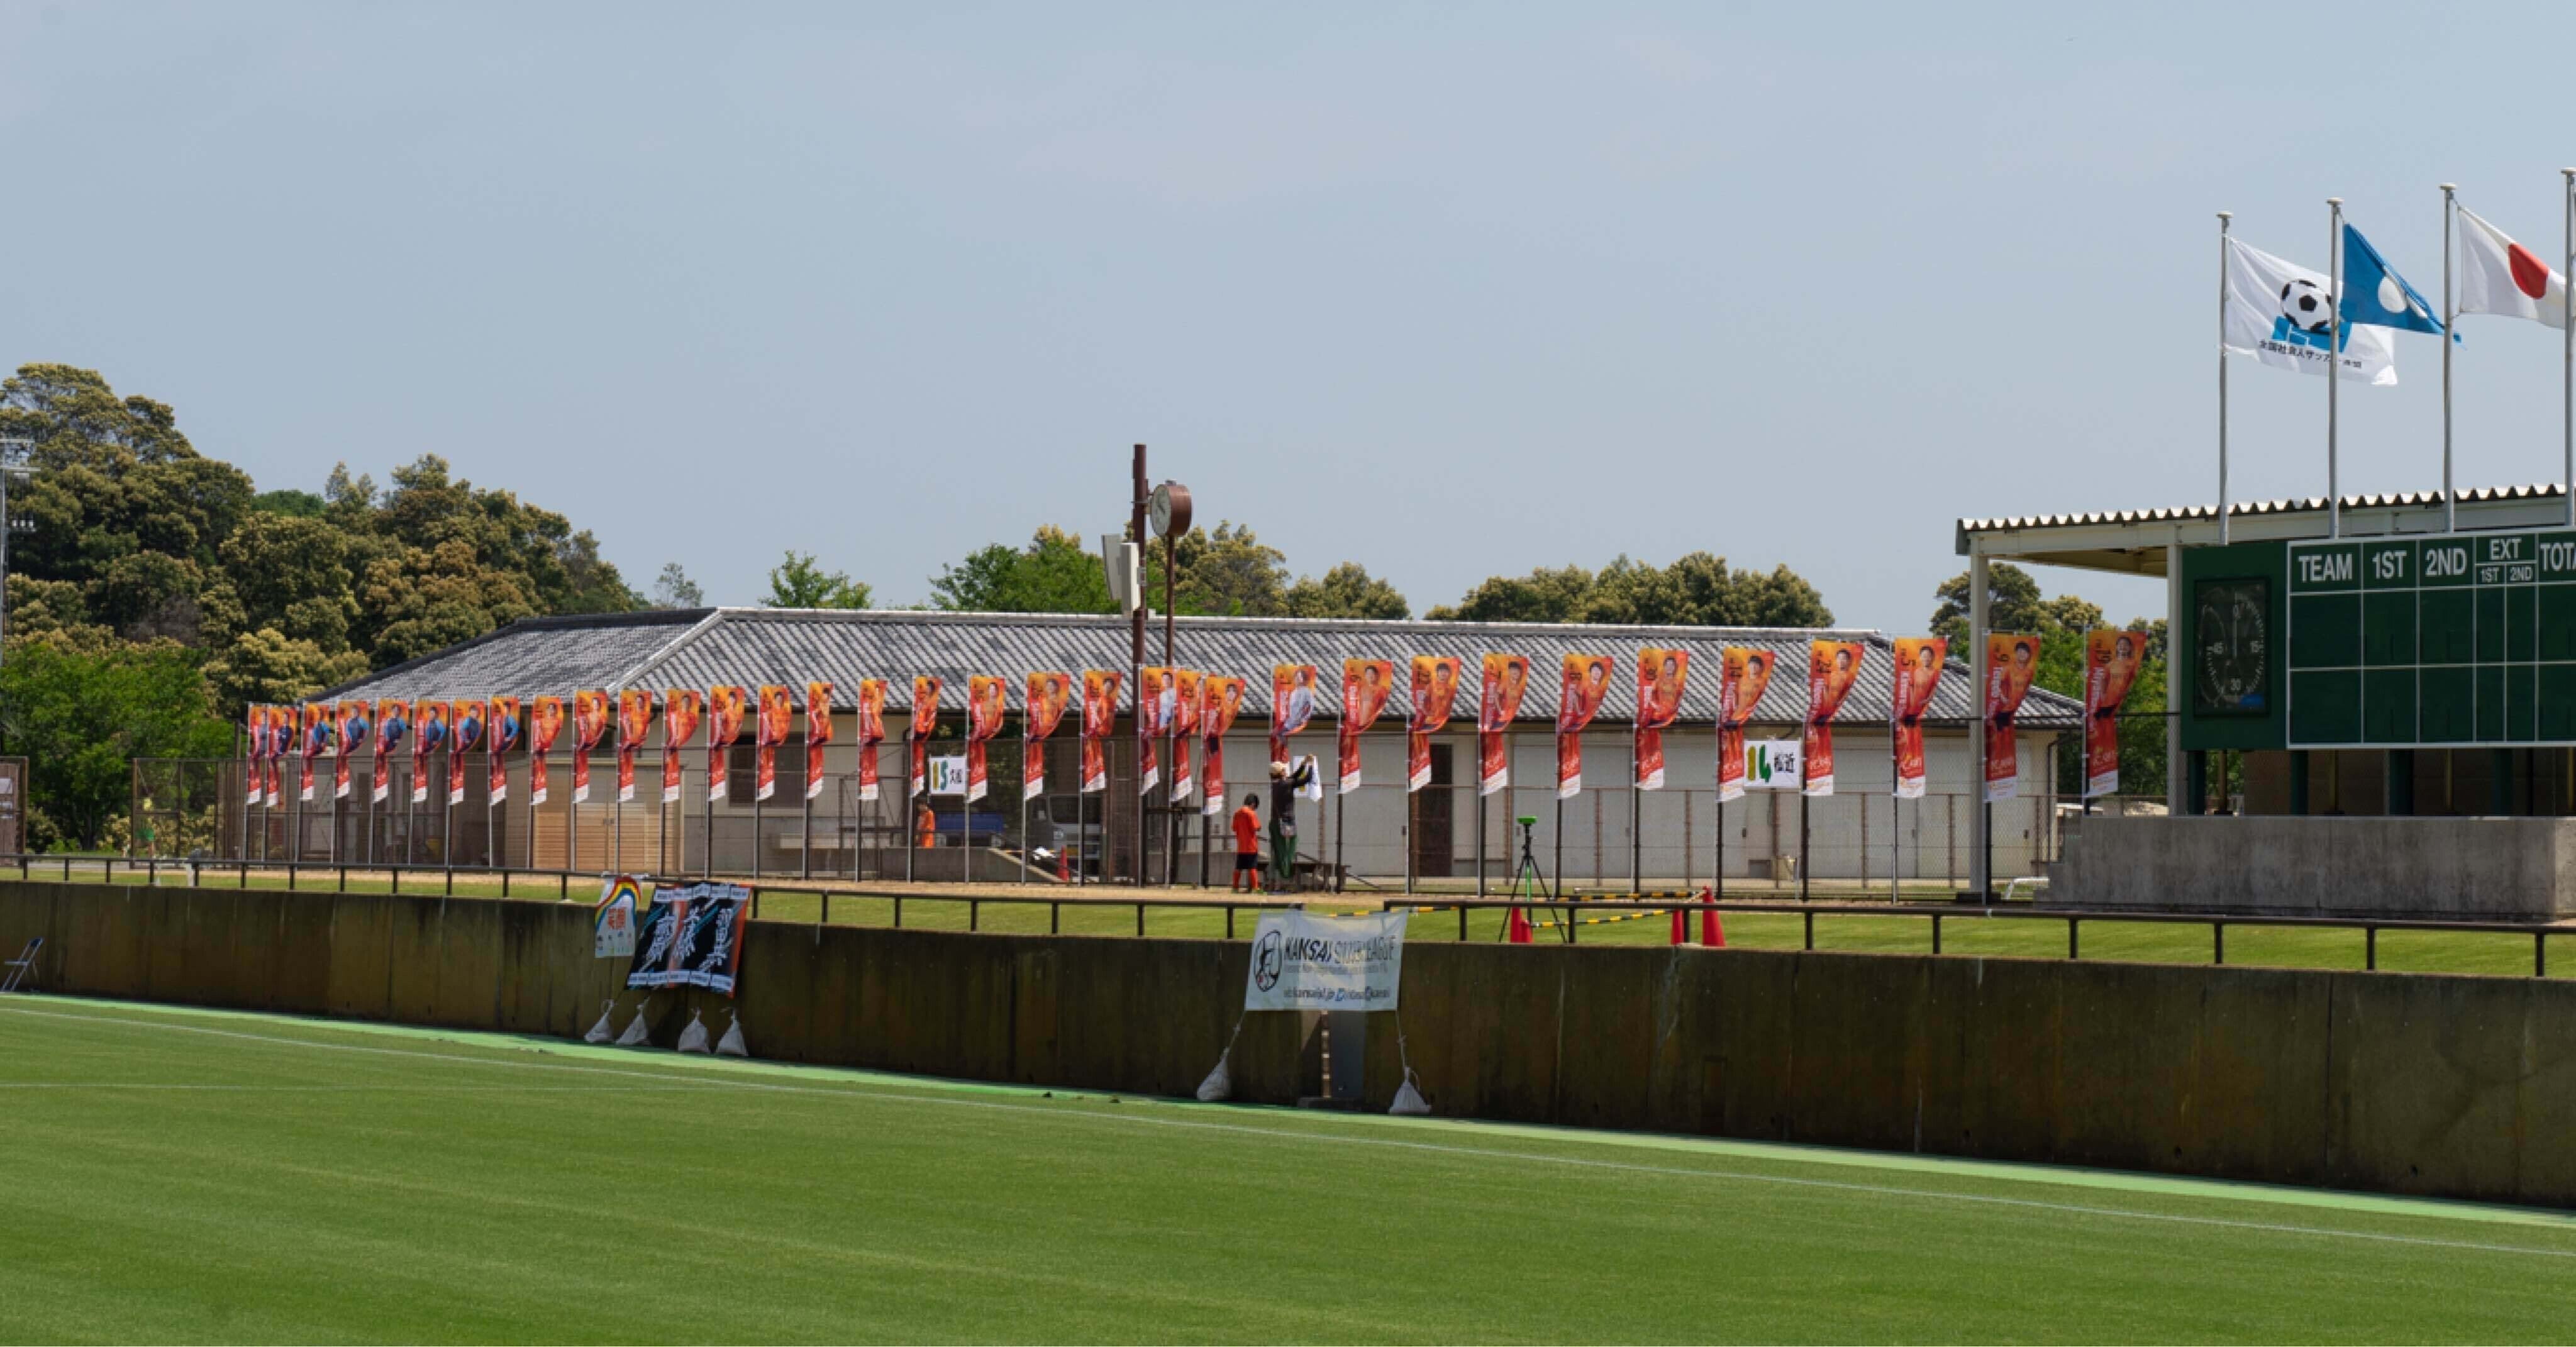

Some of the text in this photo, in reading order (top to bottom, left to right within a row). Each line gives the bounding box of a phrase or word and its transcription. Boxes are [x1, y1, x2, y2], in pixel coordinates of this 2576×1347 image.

[2297, 553, 2353, 582] TEAM
[2372, 550, 2407, 579] 1ST
[2425, 548, 2467, 577] 2ND
[2489, 538, 2522, 561] EXT
[2481, 566, 2534, 584] 1ST 2ND
[2250, 640, 2260, 653] 15
[2230, 678, 2241, 691] 30
[1284, 936, 1331, 962] KANSAI
